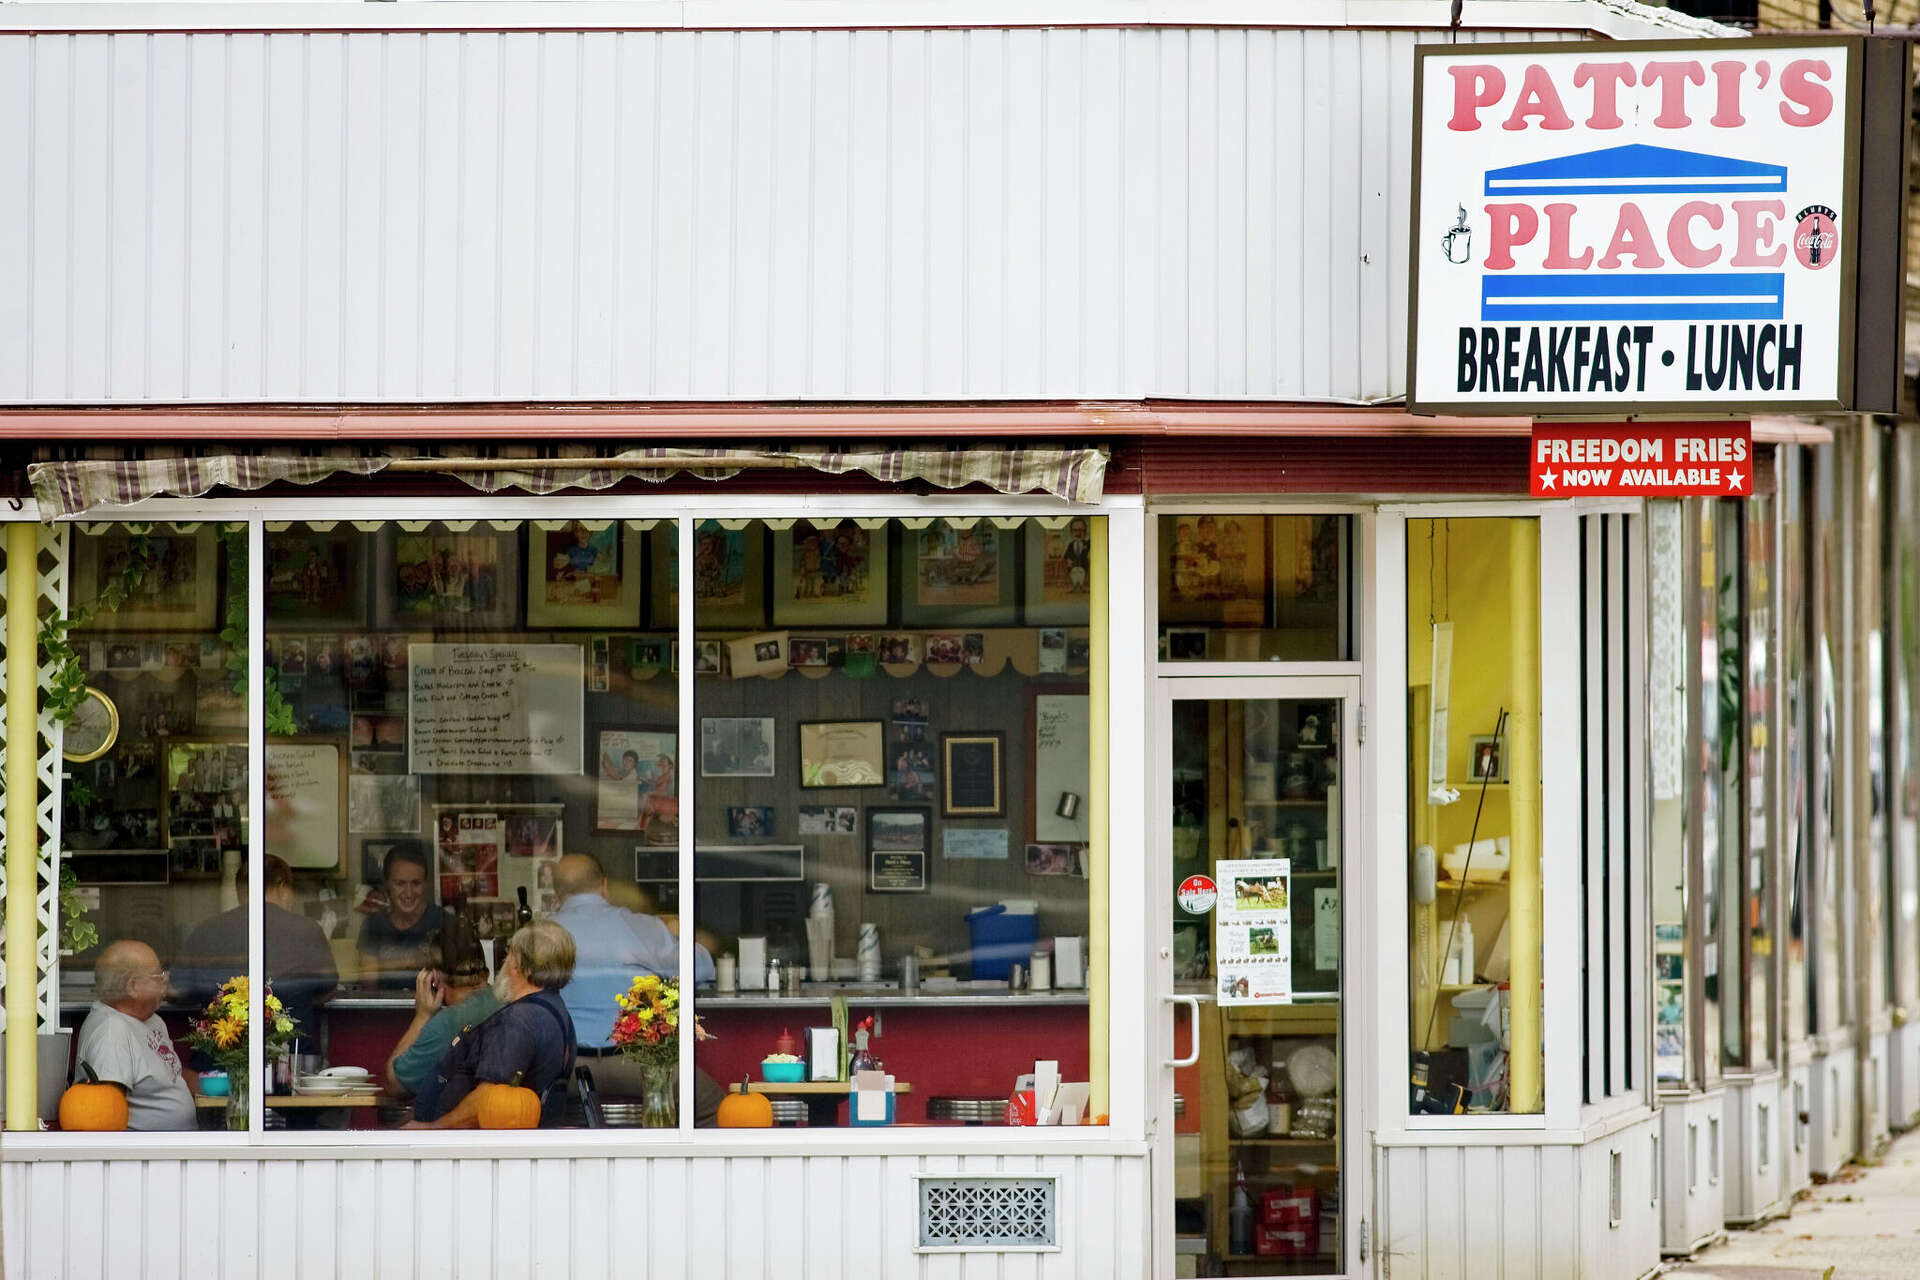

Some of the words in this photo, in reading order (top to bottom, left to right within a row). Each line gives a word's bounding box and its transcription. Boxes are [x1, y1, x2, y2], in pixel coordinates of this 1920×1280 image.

[1447, 59, 1834, 131] PATTI'S
[1483, 200, 1787, 270] PLACE
[1797, 206, 1836, 221] ALWAYS
[1457, 325, 1654, 393] BREAKFAST
[1685, 324, 1803, 391] LUNCH
[1537, 438, 1663, 464] FREEDOM
[1675, 437, 1747, 462] FRIES
[1563, 469, 1614, 487] NOW
[1619, 468, 1721, 487] AVAILABLE
